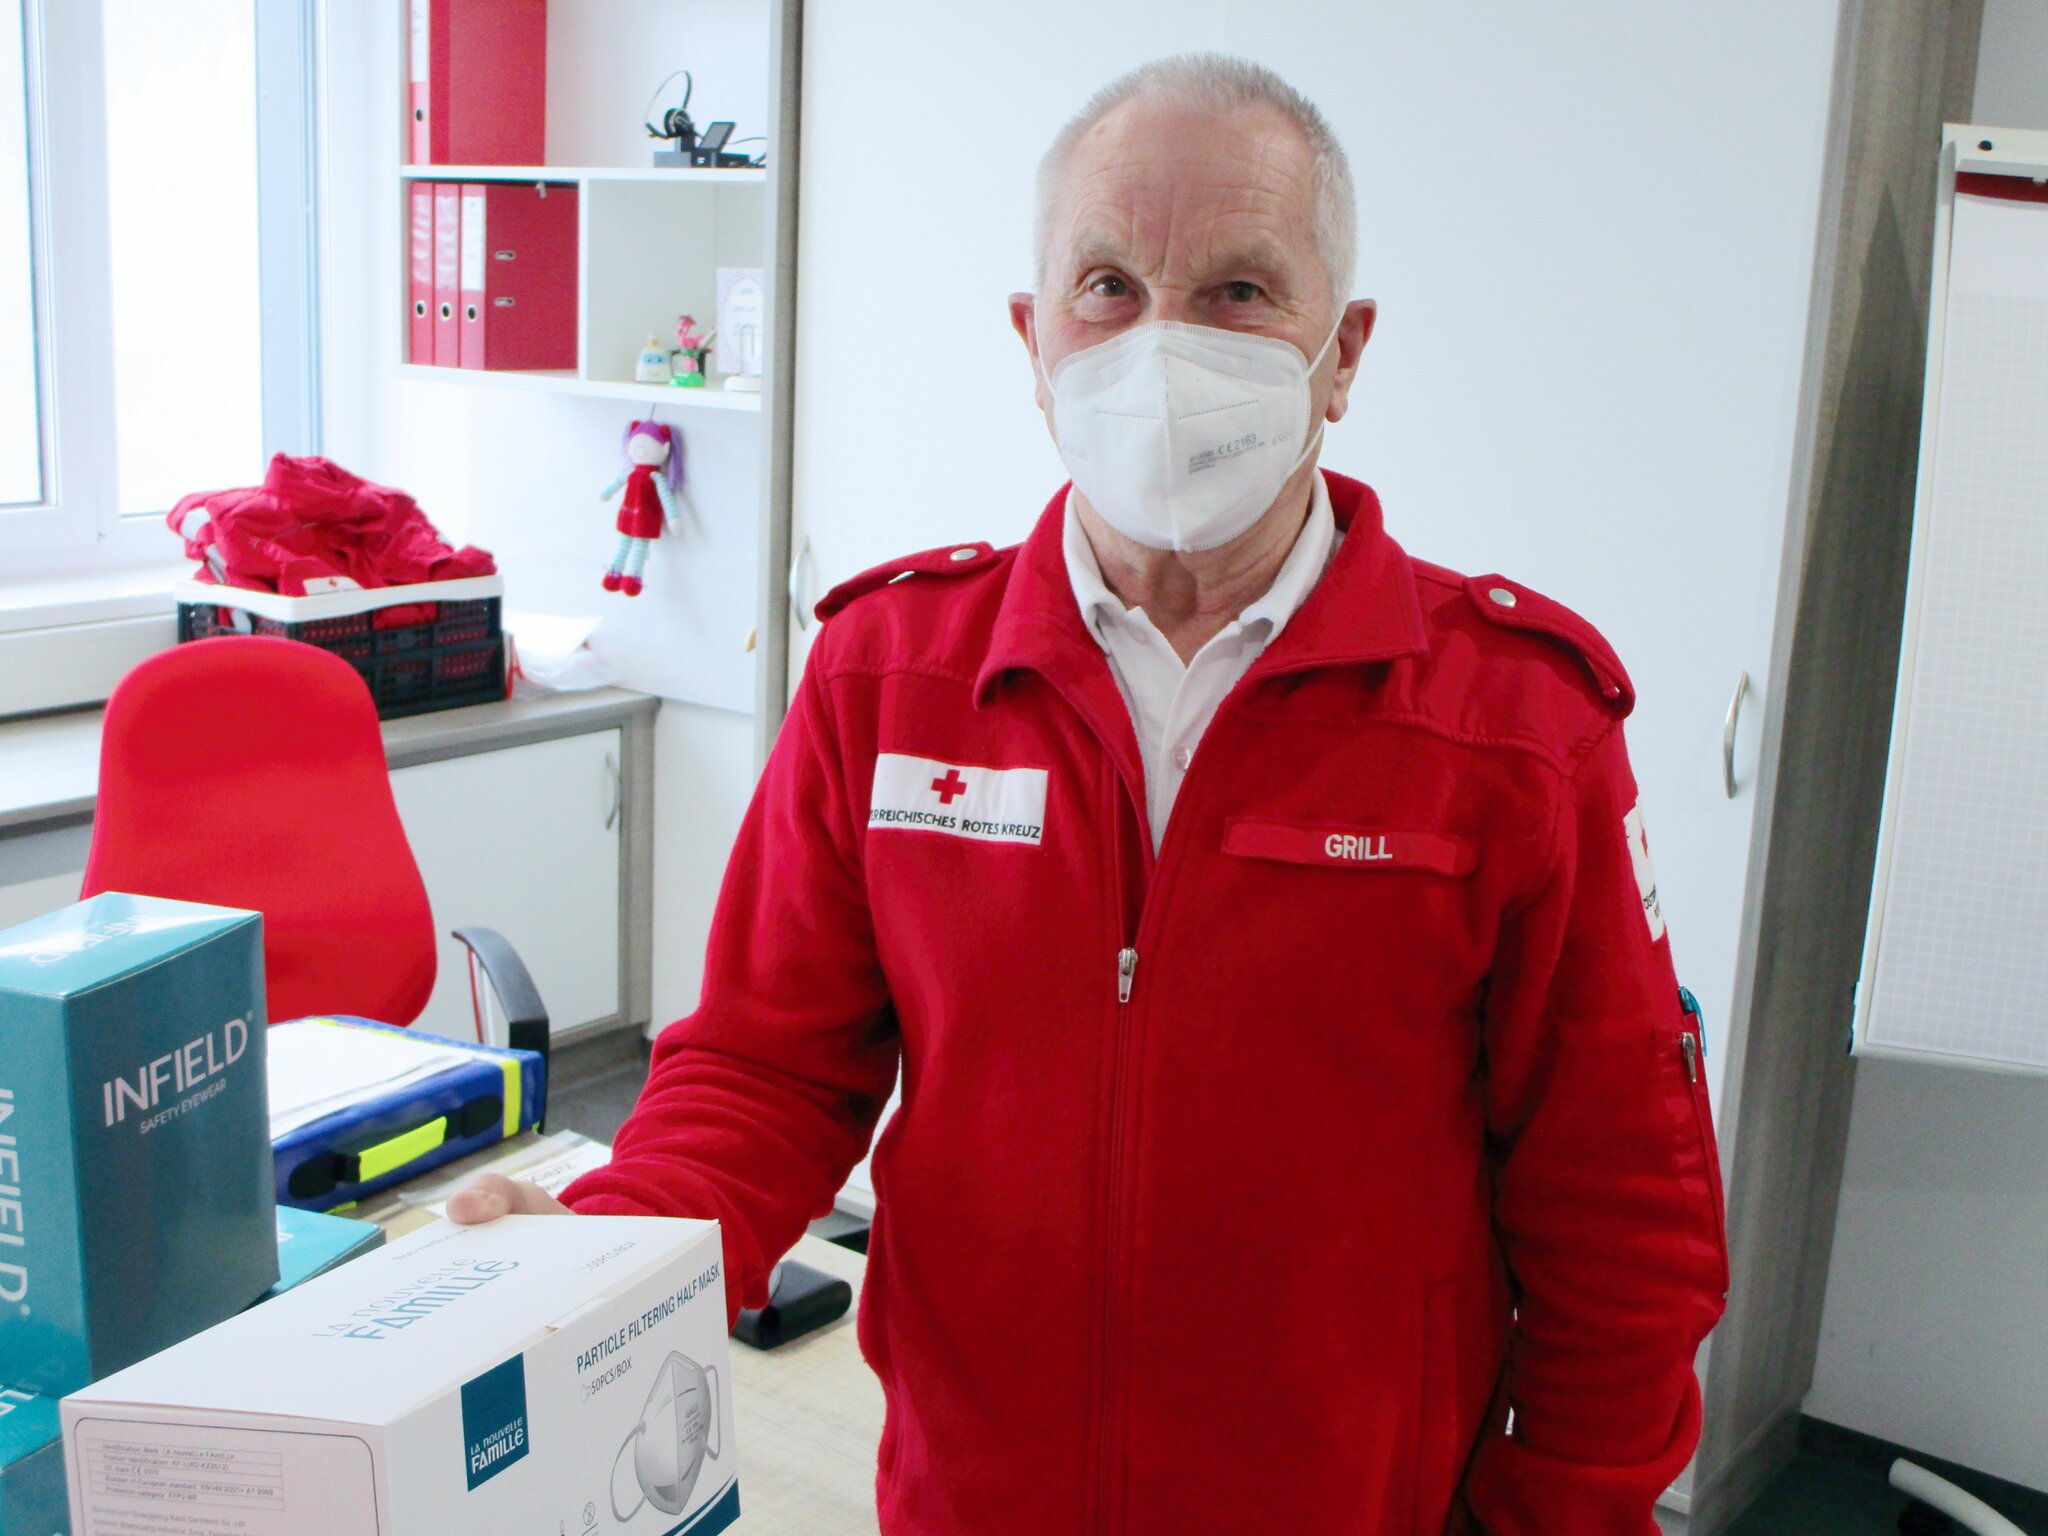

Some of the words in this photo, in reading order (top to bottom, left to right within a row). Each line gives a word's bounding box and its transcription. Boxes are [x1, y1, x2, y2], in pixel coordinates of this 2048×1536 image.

[1234, 432, 1257, 450] 2163
[961, 819, 999, 835] ROTES
[1001, 823, 1041, 839] KREUZ
[1325, 834, 1393, 860] GRILL
[102, 1017, 249, 1128] INFIELD
[140, 1101, 181, 1134] SAFETY
[181, 1078, 227, 1113] EYEWEAR
[576, 1327, 626, 1374] PARTICLE
[628, 1296, 675, 1341] FILTERING
[677, 1279, 698, 1308] HALF
[698, 1261, 721, 1293] MASK
[591, 1356, 633, 1395] 50PCS/BOX
